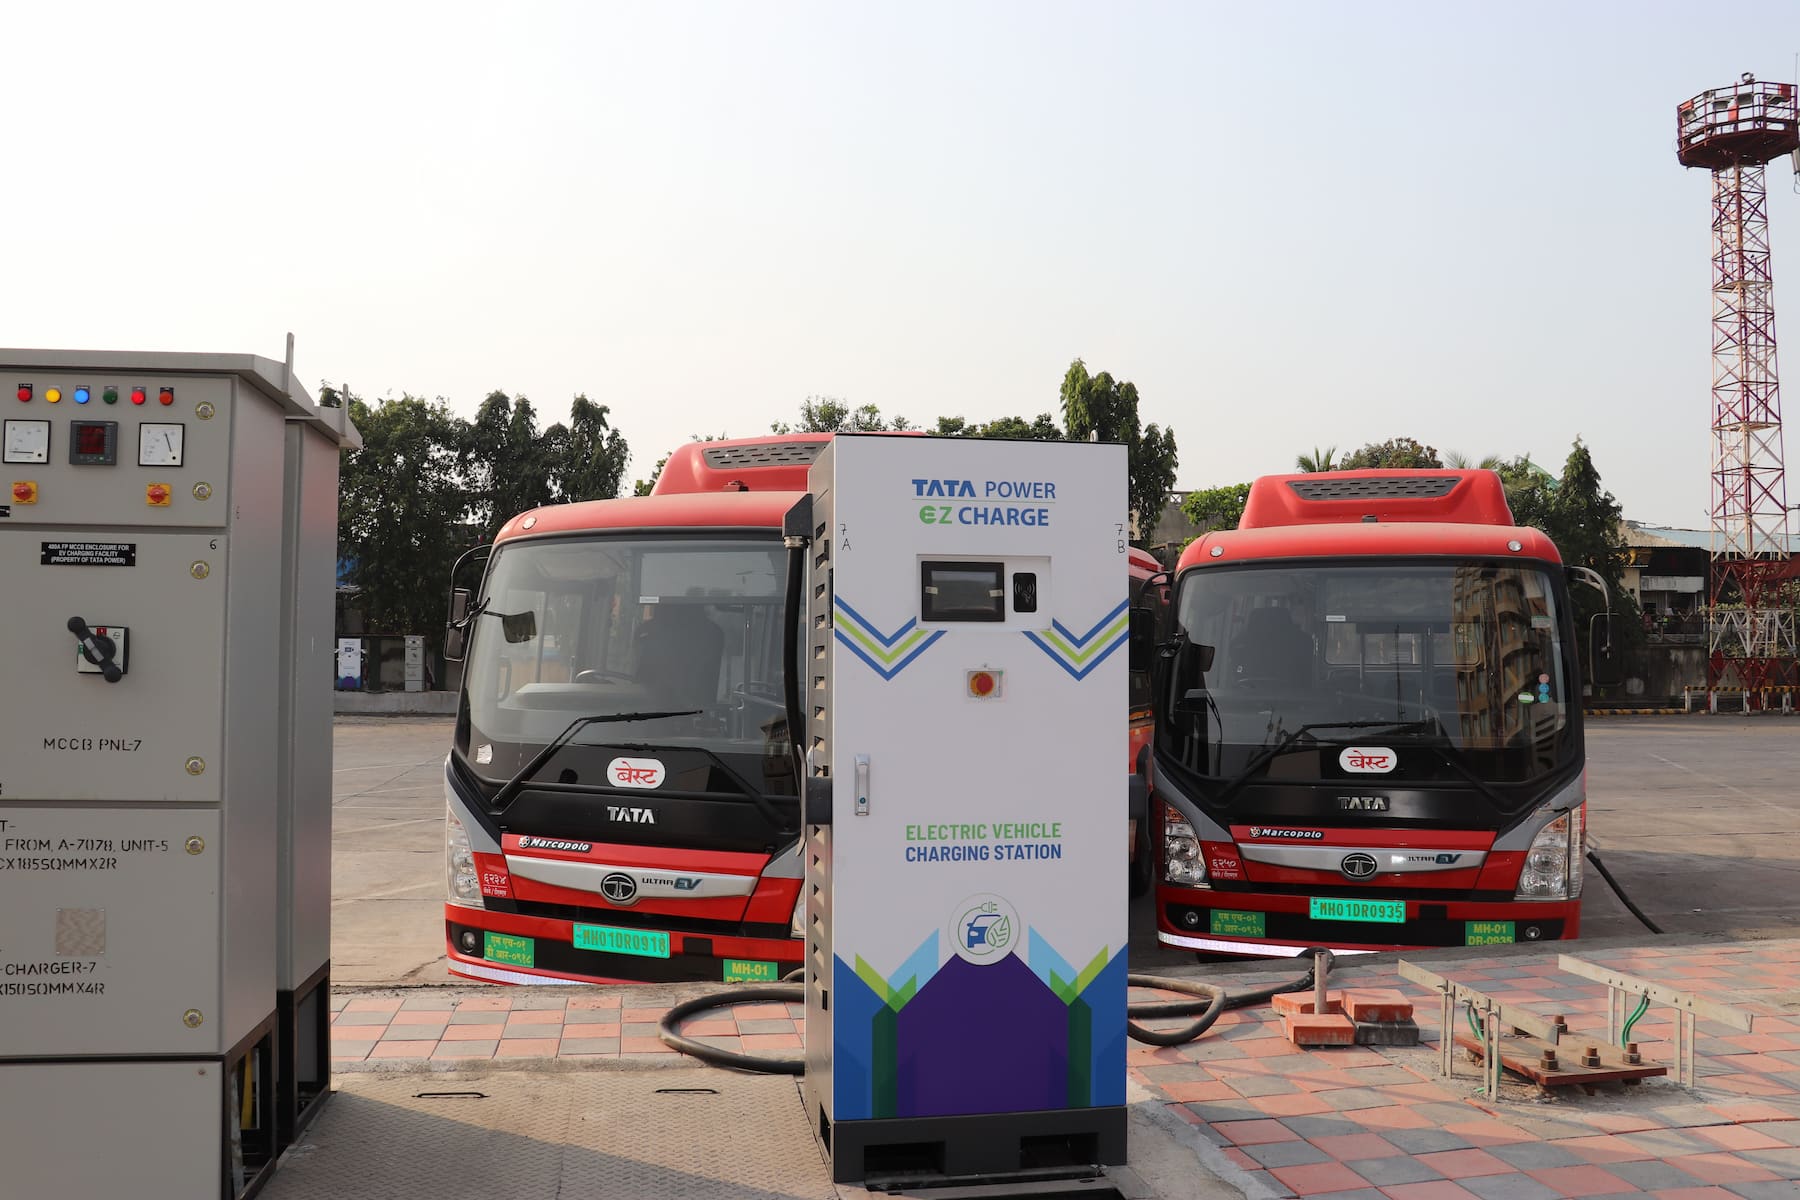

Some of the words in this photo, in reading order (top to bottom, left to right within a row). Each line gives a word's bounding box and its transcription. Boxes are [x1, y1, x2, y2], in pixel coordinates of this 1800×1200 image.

[912, 479, 976, 497] TATA
[985, 481, 1056, 499] POWER
[958, 507, 1049, 526] CHARGE
[840, 523, 847, 536] 7
[1114, 523, 1123, 536] 7
[209, 538, 217, 550] 6
[841, 538, 852, 551] A
[1117, 539, 1126, 554] B
[43, 738, 92, 751] MCCB
[99, 738, 142, 752] PNL-7
[1347, 750, 1390, 770] बेस्ट
[615, 760, 658, 785] बेस्ट
[1338, 796, 1387, 810] TATA
[607, 806, 655, 824] TATA
[905, 824, 987, 841] ELECTRIC
[993, 822, 1062, 839] VEHICLE
[1261, 828, 1323, 839] Marcopolo
[121, 840, 168, 852] UNIT-5
[530, 837, 589, 851] Marcopolo
[905, 845, 990, 862] CHARGING
[994, 844, 1062, 860] STATION
[1435, 854, 1464, 864] EV
[642, 877, 673, 886] ULTRA
[674, 878, 703, 890] EV
[1320, 902, 1403, 918] MH01DR0935
[1473, 924, 1506, 934] MH-01
[732, 962, 768, 976] MH-01
